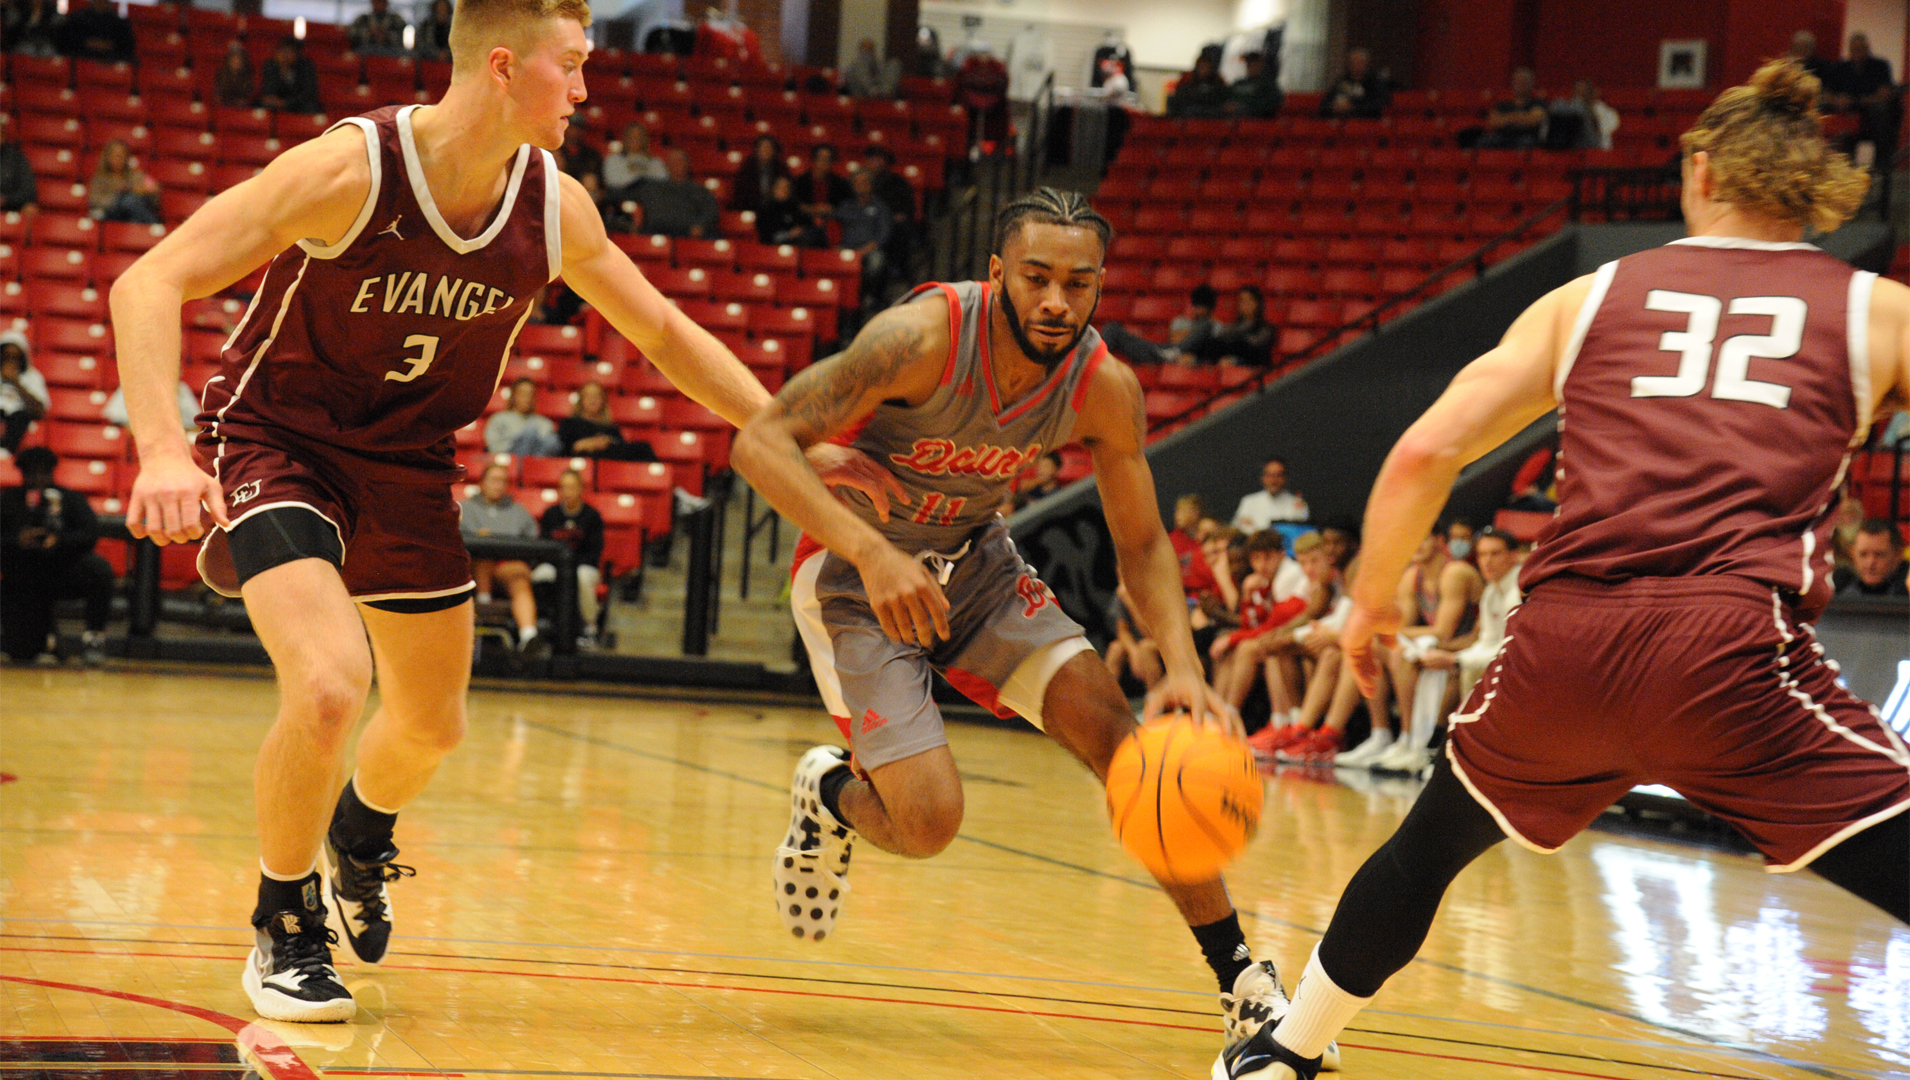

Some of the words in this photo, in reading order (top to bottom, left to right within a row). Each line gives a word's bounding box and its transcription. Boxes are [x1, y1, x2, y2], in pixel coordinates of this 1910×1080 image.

[384, 334, 440, 383] 3
[1630, 288, 1808, 409] 32
[913, 492, 967, 526] 11
